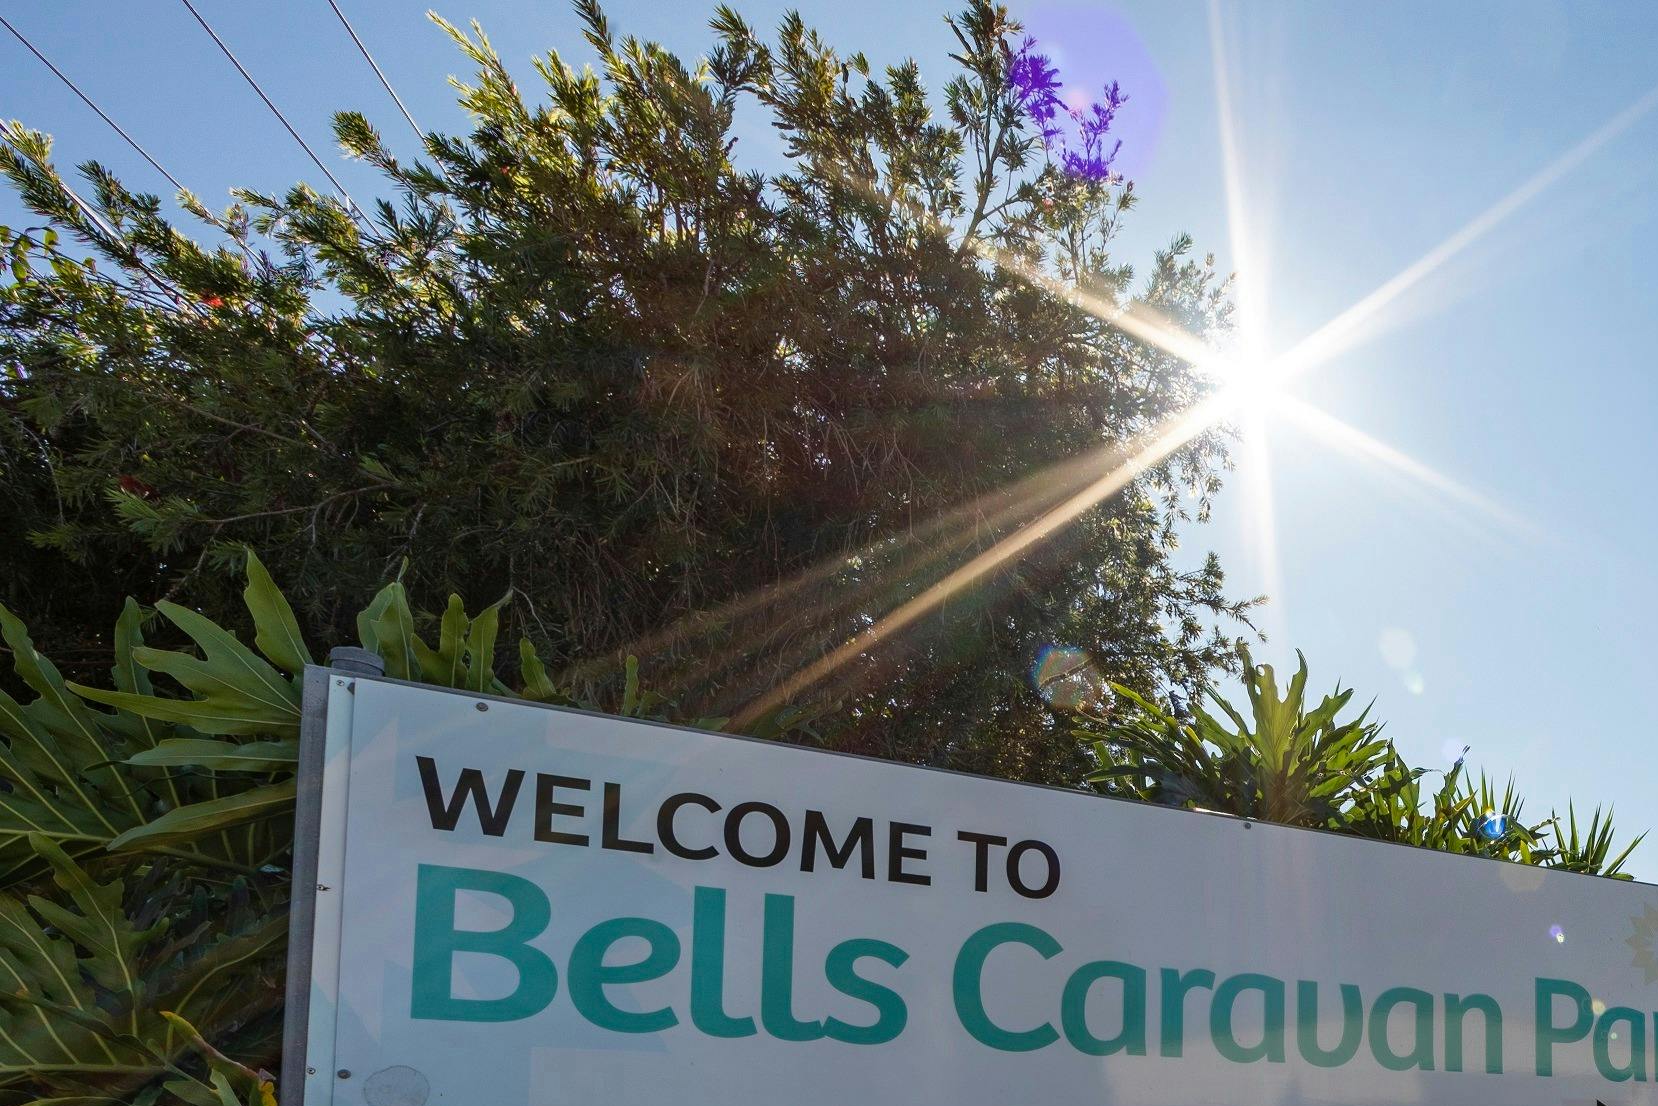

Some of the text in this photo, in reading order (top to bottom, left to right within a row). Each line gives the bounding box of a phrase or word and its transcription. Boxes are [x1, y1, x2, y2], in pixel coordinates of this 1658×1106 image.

[416, 755, 1061, 899] WELCOME TO
[410, 863, 910, 1045] Bells
[952, 922, 1503, 1074] Caravan
